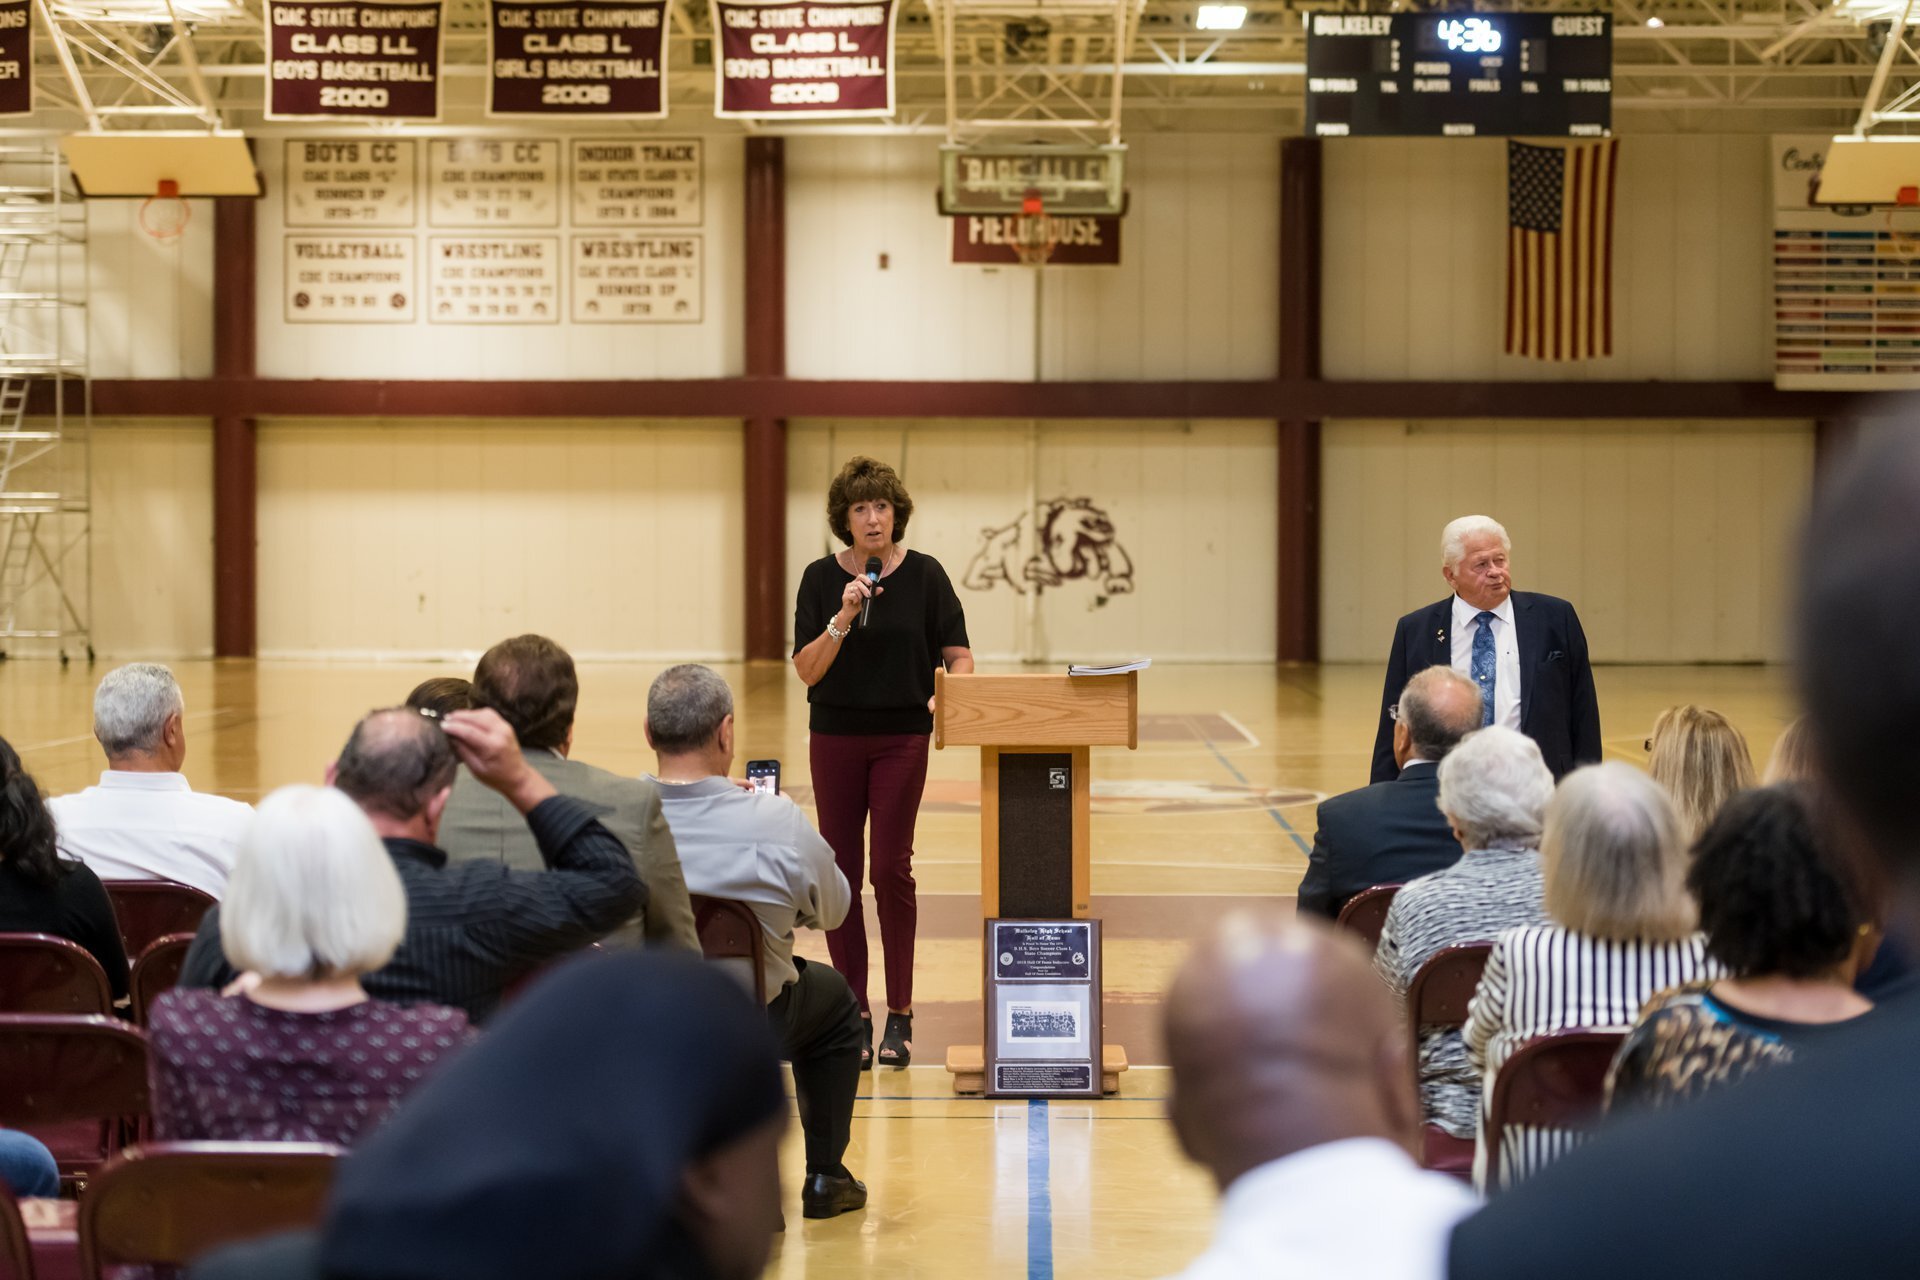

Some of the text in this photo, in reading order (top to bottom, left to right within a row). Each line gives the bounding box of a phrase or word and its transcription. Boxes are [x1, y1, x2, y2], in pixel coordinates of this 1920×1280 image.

[310, 8, 357, 28] STATE
[360, 9, 438, 28] CHAMPIONS
[534, 8, 580, 28] STATE
[583, 8, 659, 28] CHAMPIONS
[759, 8, 805, 28] STATE
[807, 6, 884, 27] CHAMPIONS
[1314, 16, 1392, 36] BULKELEY
[1552, 16, 1605, 36] GUEST
[291, 34, 418, 55] CLASS LL
[523, 34, 633, 53] CLASS L
[750, 31, 860, 54] CLASS L
[273, 60, 434, 81] BOYS BASKETBALL
[495, 59, 659, 79] GIRLS BASKETBALL
[724, 56, 886, 79] BOYS BASKETBALL
[320, 87, 389, 108] 2000
[304, 143, 397, 163] BOYS CC
[514, 143, 541, 163] CC
[578, 146, 696, 162] INDOOR TRACK
[471, 170, 545, 182] CHAMPIONS
[600, 187, 675, 200] CHAMPIONS
[295, 244, 405, 259] VOLLEYBALL
[441, 243, 543, 260] WRESTLING
[581, 241, 695, 259] WRESTLING
[329, 272, 401, 283] CHAMPIONS
[471, 268, 544, 279] CHAMPIONS
[1038, 927, 1053, 935] High
